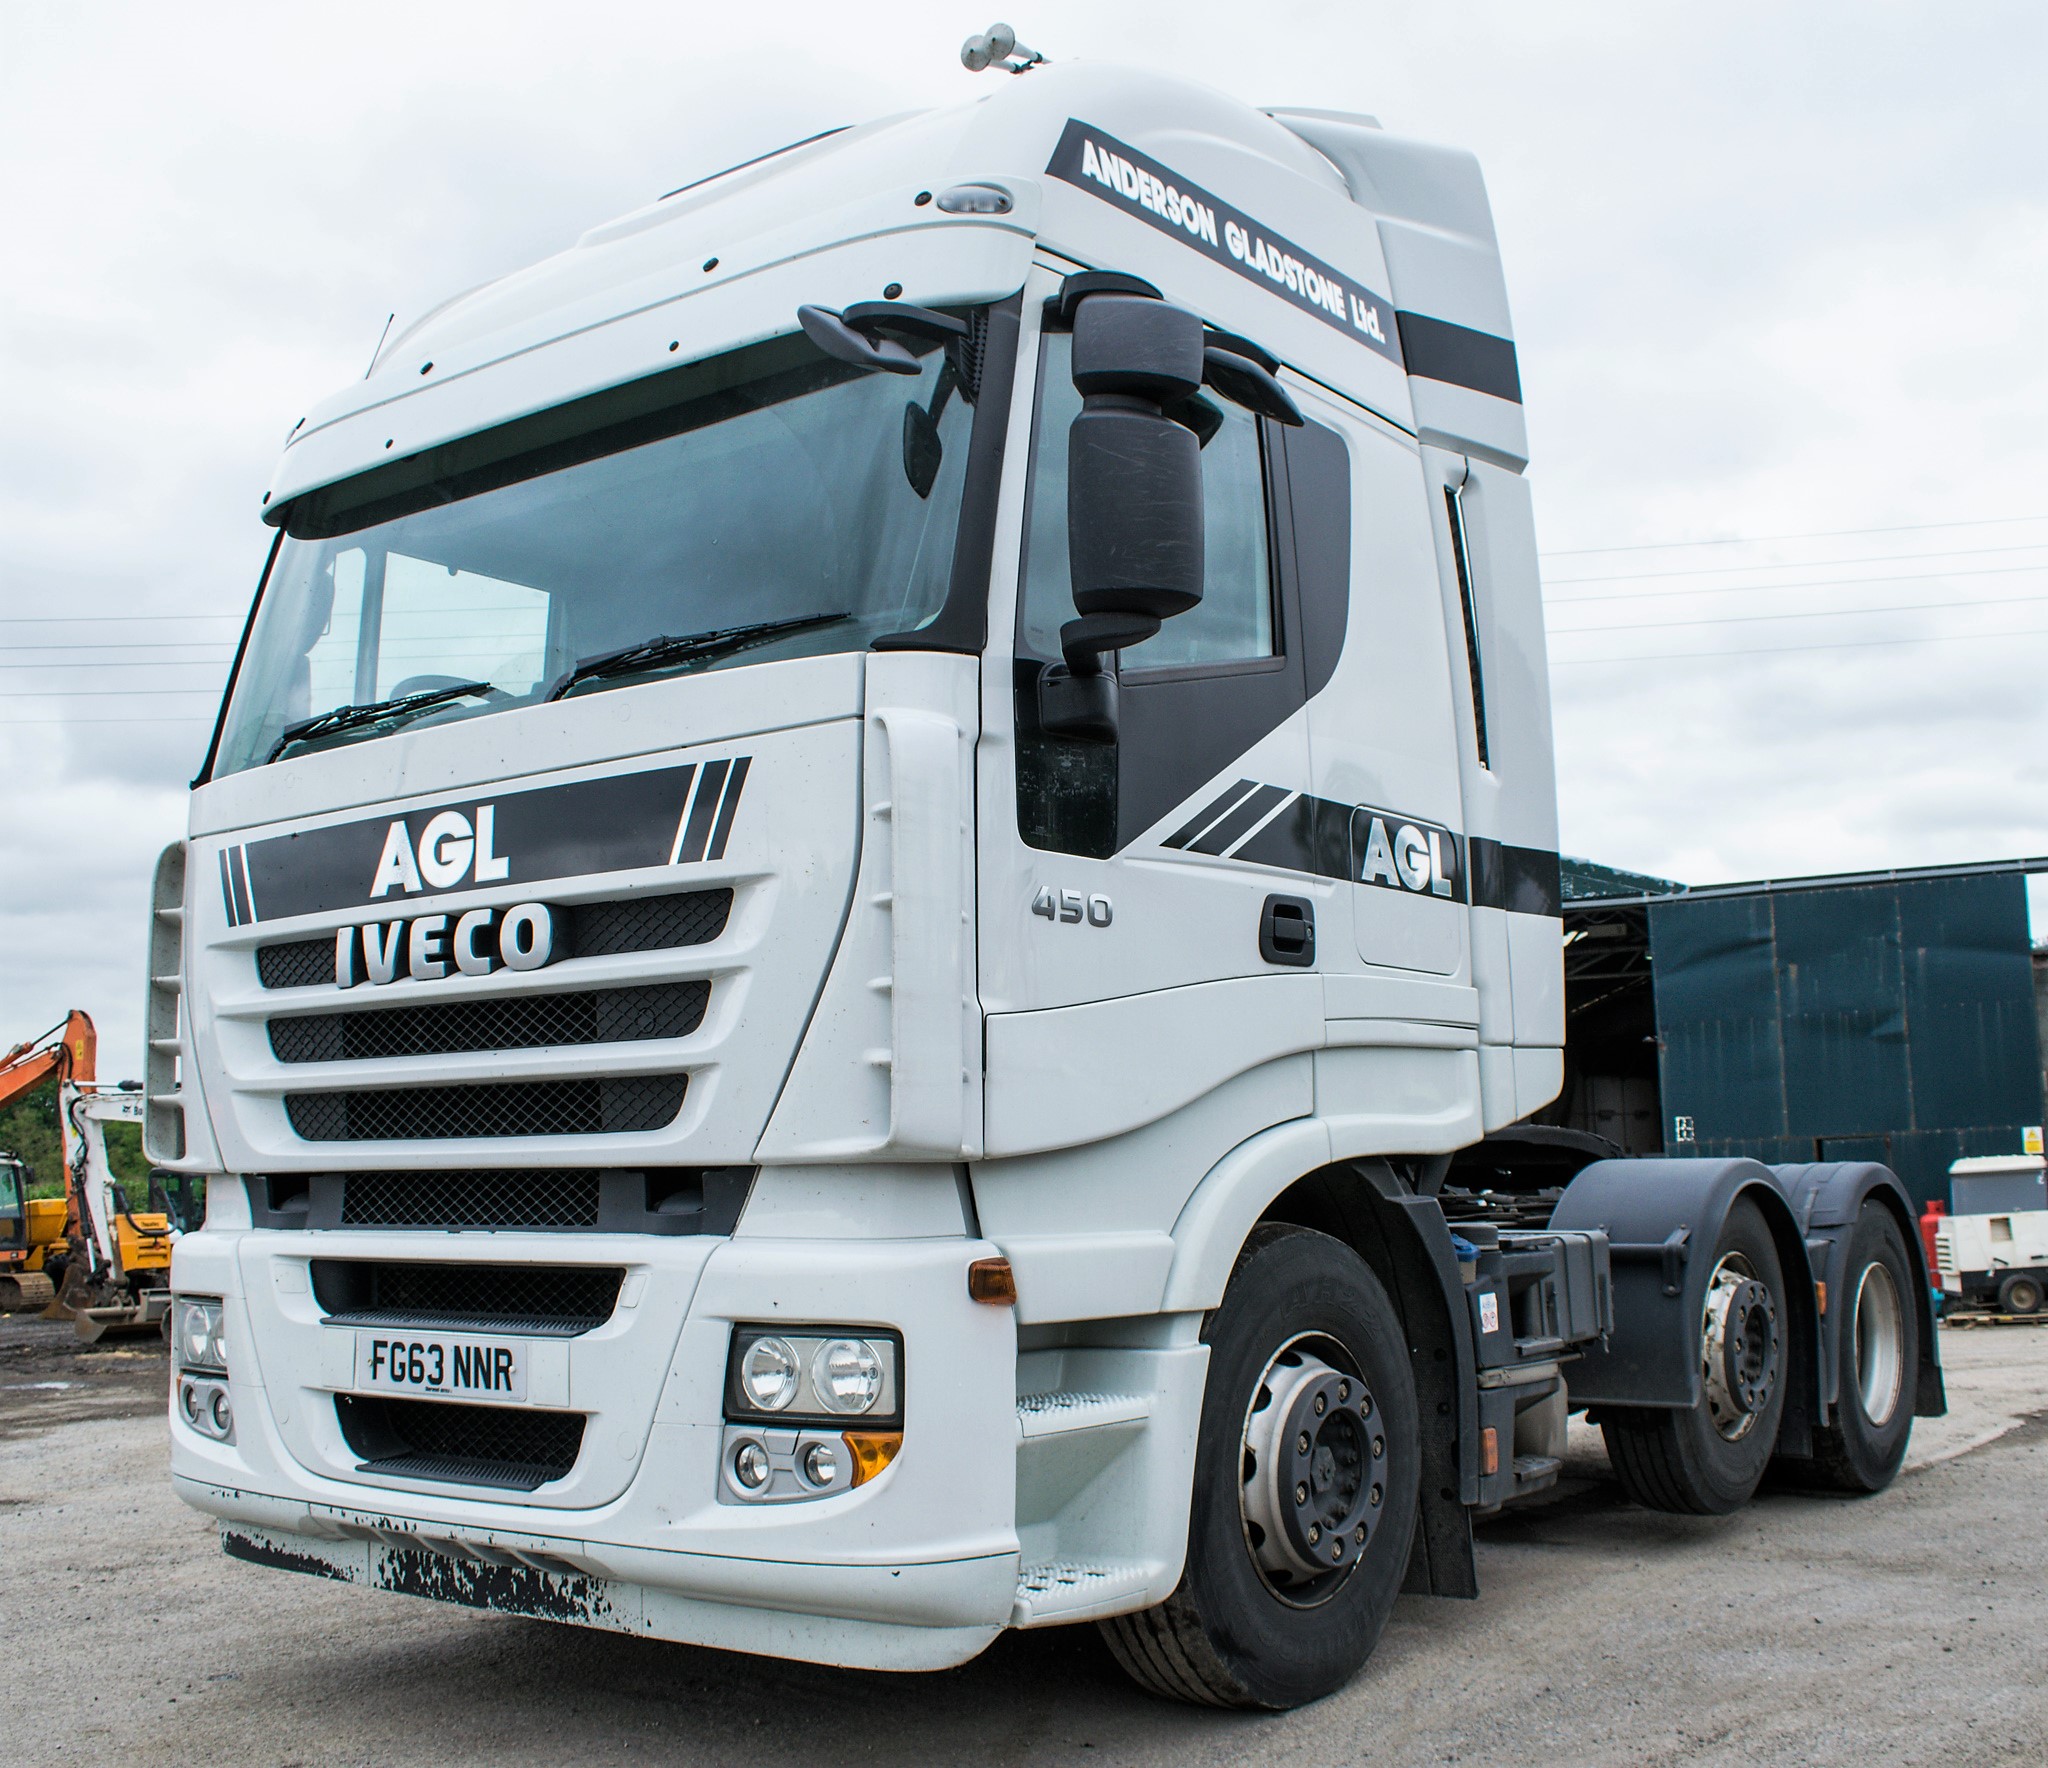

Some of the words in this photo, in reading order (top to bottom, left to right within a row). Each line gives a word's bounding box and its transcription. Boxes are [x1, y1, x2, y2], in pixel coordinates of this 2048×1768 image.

[1082, 140, 1218, 247] ANDERSON
[1225, 221, 1346, 321] GLADSTONE
[1350, 294, 1386, 344] Ltd.
[369, 804, 510, 898] AGL
[1361, 817, 1453, 898] AGL
[335, 902, 556, 989] IVECO
[1031, 886, 1113, 928] 450
[372, 1340, 444, 1386] FG63
[453, 1345, 512, 1391] NNR
